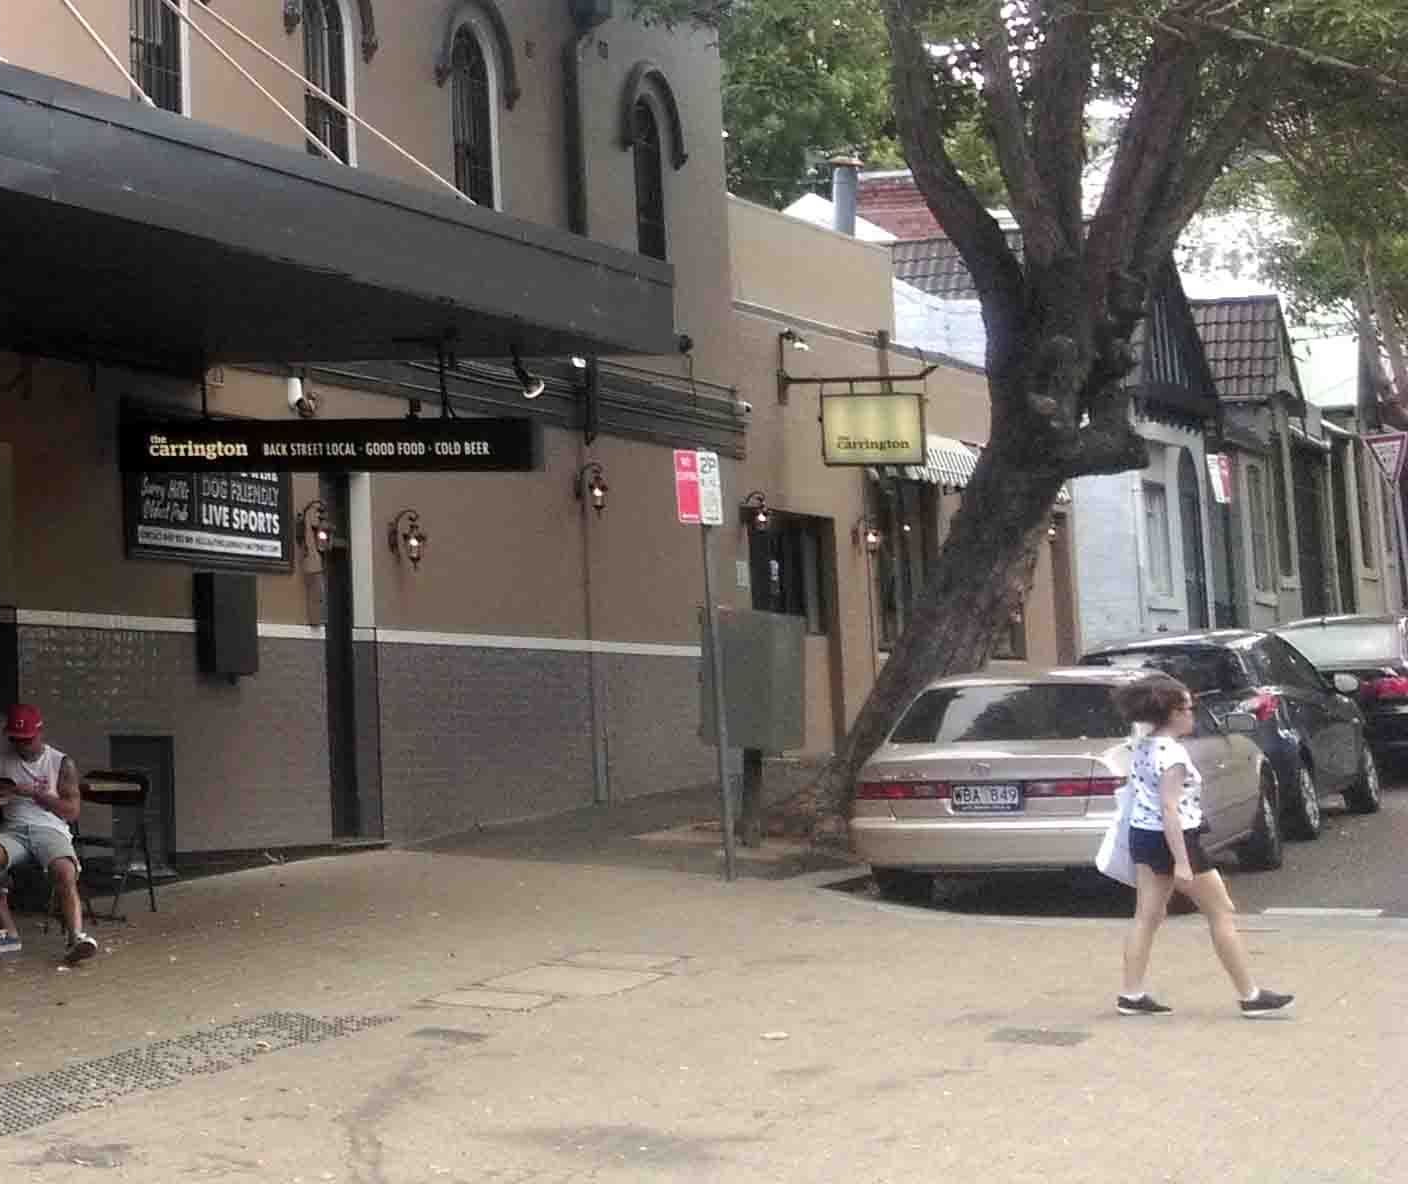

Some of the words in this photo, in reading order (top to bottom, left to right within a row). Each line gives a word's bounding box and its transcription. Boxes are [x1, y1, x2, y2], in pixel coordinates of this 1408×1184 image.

[150, 435, 167, 444] the
[837, 439, 910, 451] carrington
[150, 441, 248, 459] carrington
[263, 443, 287, 456] BACK
[290, 443, 322, 456] STREET
[326, 442, 357, 456] LOCAL
[365, 442, 395, 456] GOOD
[397, 442, 425, 455] FOOD
[434, 442, 461, 456] COLD
[464, 442, 490, 455] BEER
[201, 479, 228, 498] DOG
[231, 480, 280, 506] FRIENDLY
[202, 504, 230, 527] LIVE
[232, 507, 280, 535] SPORTS
[955, 788, 981, 803] WBA
[991, 787, 1017, 802] 849
